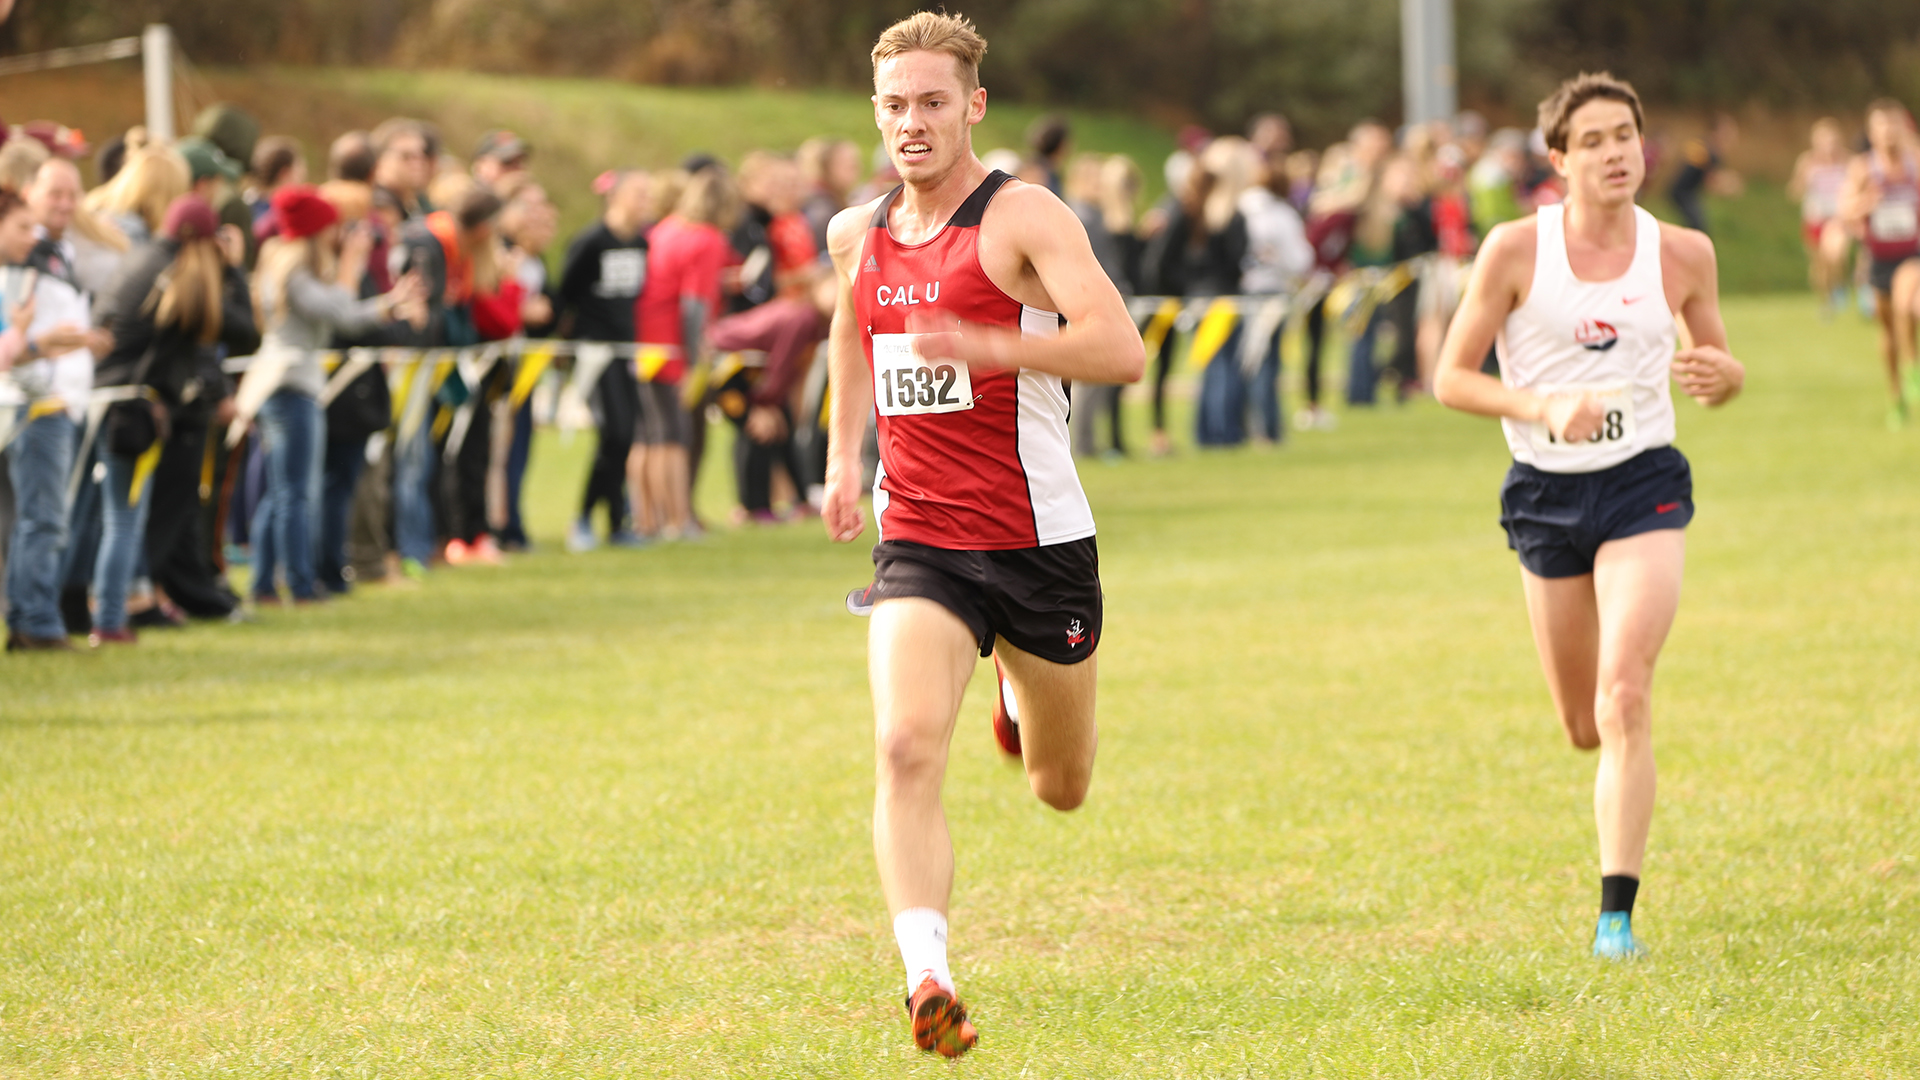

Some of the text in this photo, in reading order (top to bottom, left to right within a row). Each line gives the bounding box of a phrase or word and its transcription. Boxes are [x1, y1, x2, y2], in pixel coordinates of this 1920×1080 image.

[877, 281, 940, 306] CAL U
[882, 364, 960, 408] 1532
